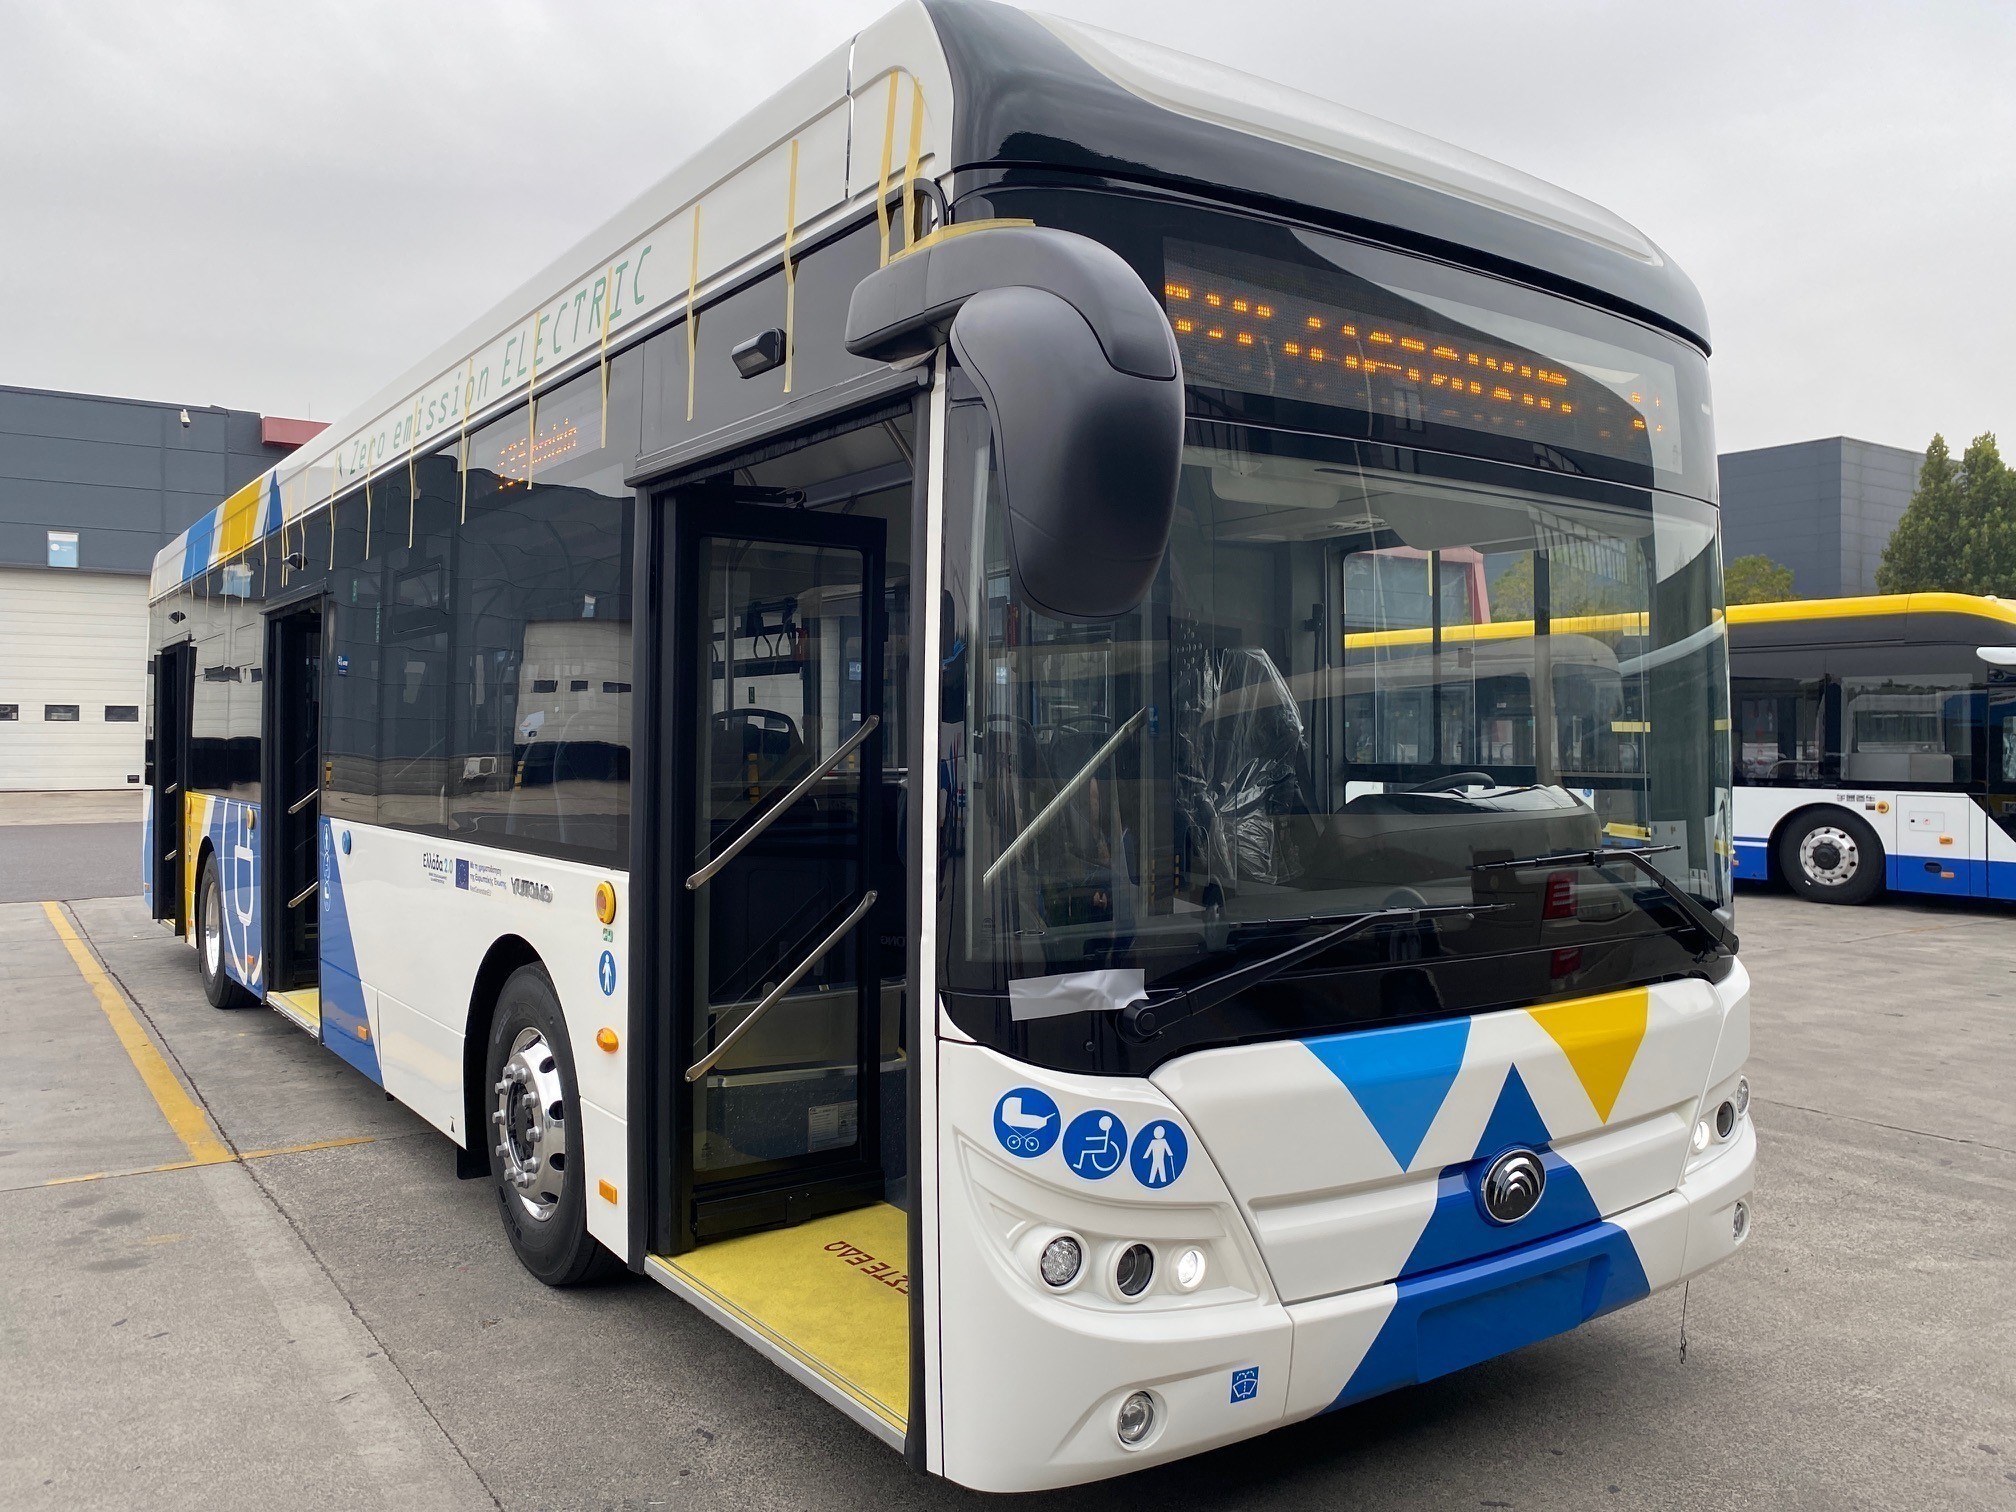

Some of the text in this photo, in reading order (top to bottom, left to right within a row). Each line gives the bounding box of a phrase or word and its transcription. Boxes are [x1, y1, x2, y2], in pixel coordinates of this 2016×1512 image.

[349, 245, 652, 475] Zero emission ELECTRIC
[510, 877, 554, 904] YUTONG
